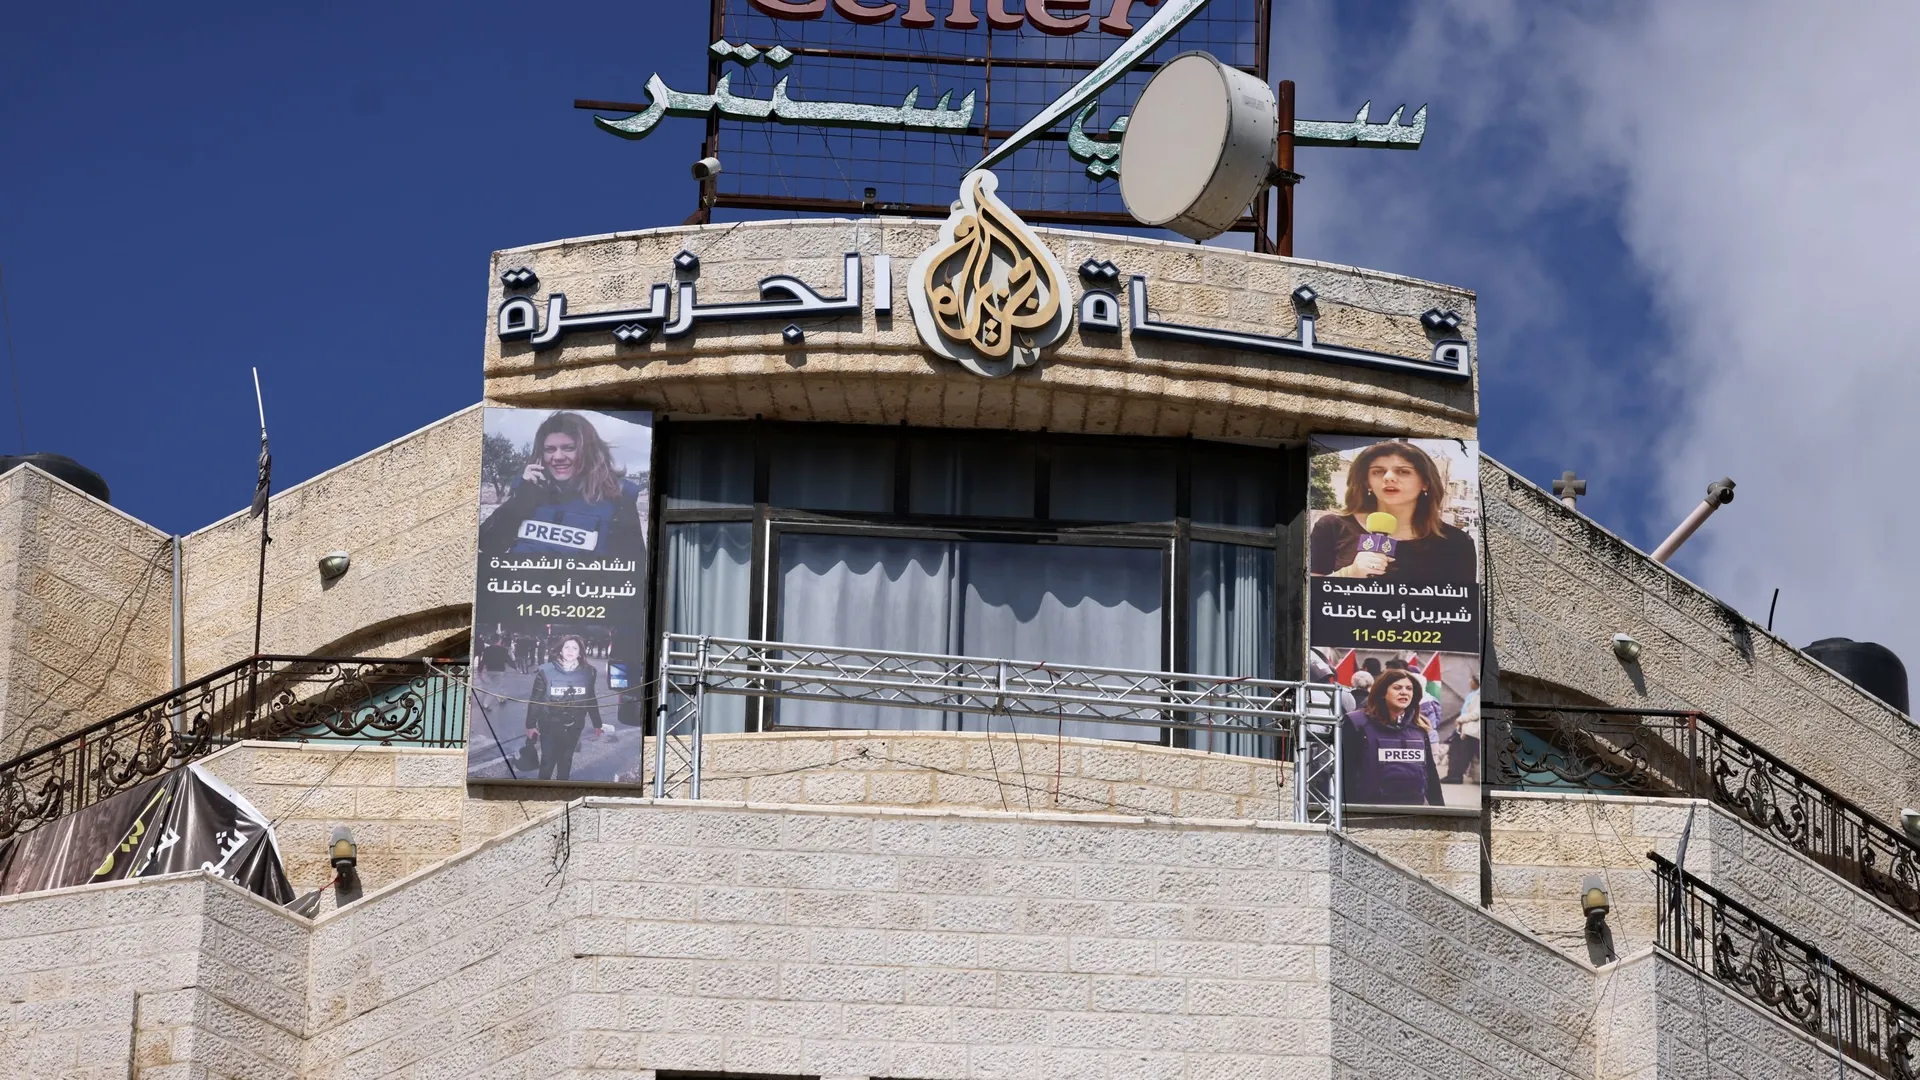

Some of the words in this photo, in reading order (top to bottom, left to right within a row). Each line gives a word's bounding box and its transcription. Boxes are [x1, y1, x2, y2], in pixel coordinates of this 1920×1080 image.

[593, 38, 977, 141] سنتر
[498, 249, 891, 351] الجزيرة
[1078, 257, 1471, 382] قناة
[525, 523, 587, 546] PRESS
[490, 555, 562, 571] الشهيدة
[566, 557, 636, 572] الشاهدة
[486, 577, 542, 595] عاقلة
[546, 577, 571, 597] أبو
[575, 579, 637, 599] شيرين
[1322, 581, 1395, 596] الشهيدة
[1398, 583, 1469, 599] الشاهدة
[516, 604, 606, 619] 11-05-2022
[1321, 601, 1377, 619] عاقلة
[1381, 603, 1406, 622] أبو
[1410, 606, 1472, 624] شيرين
[1352, 628, 1442, 644] 11-05-2022
[1384, 750, 1421, 760] PRESS
